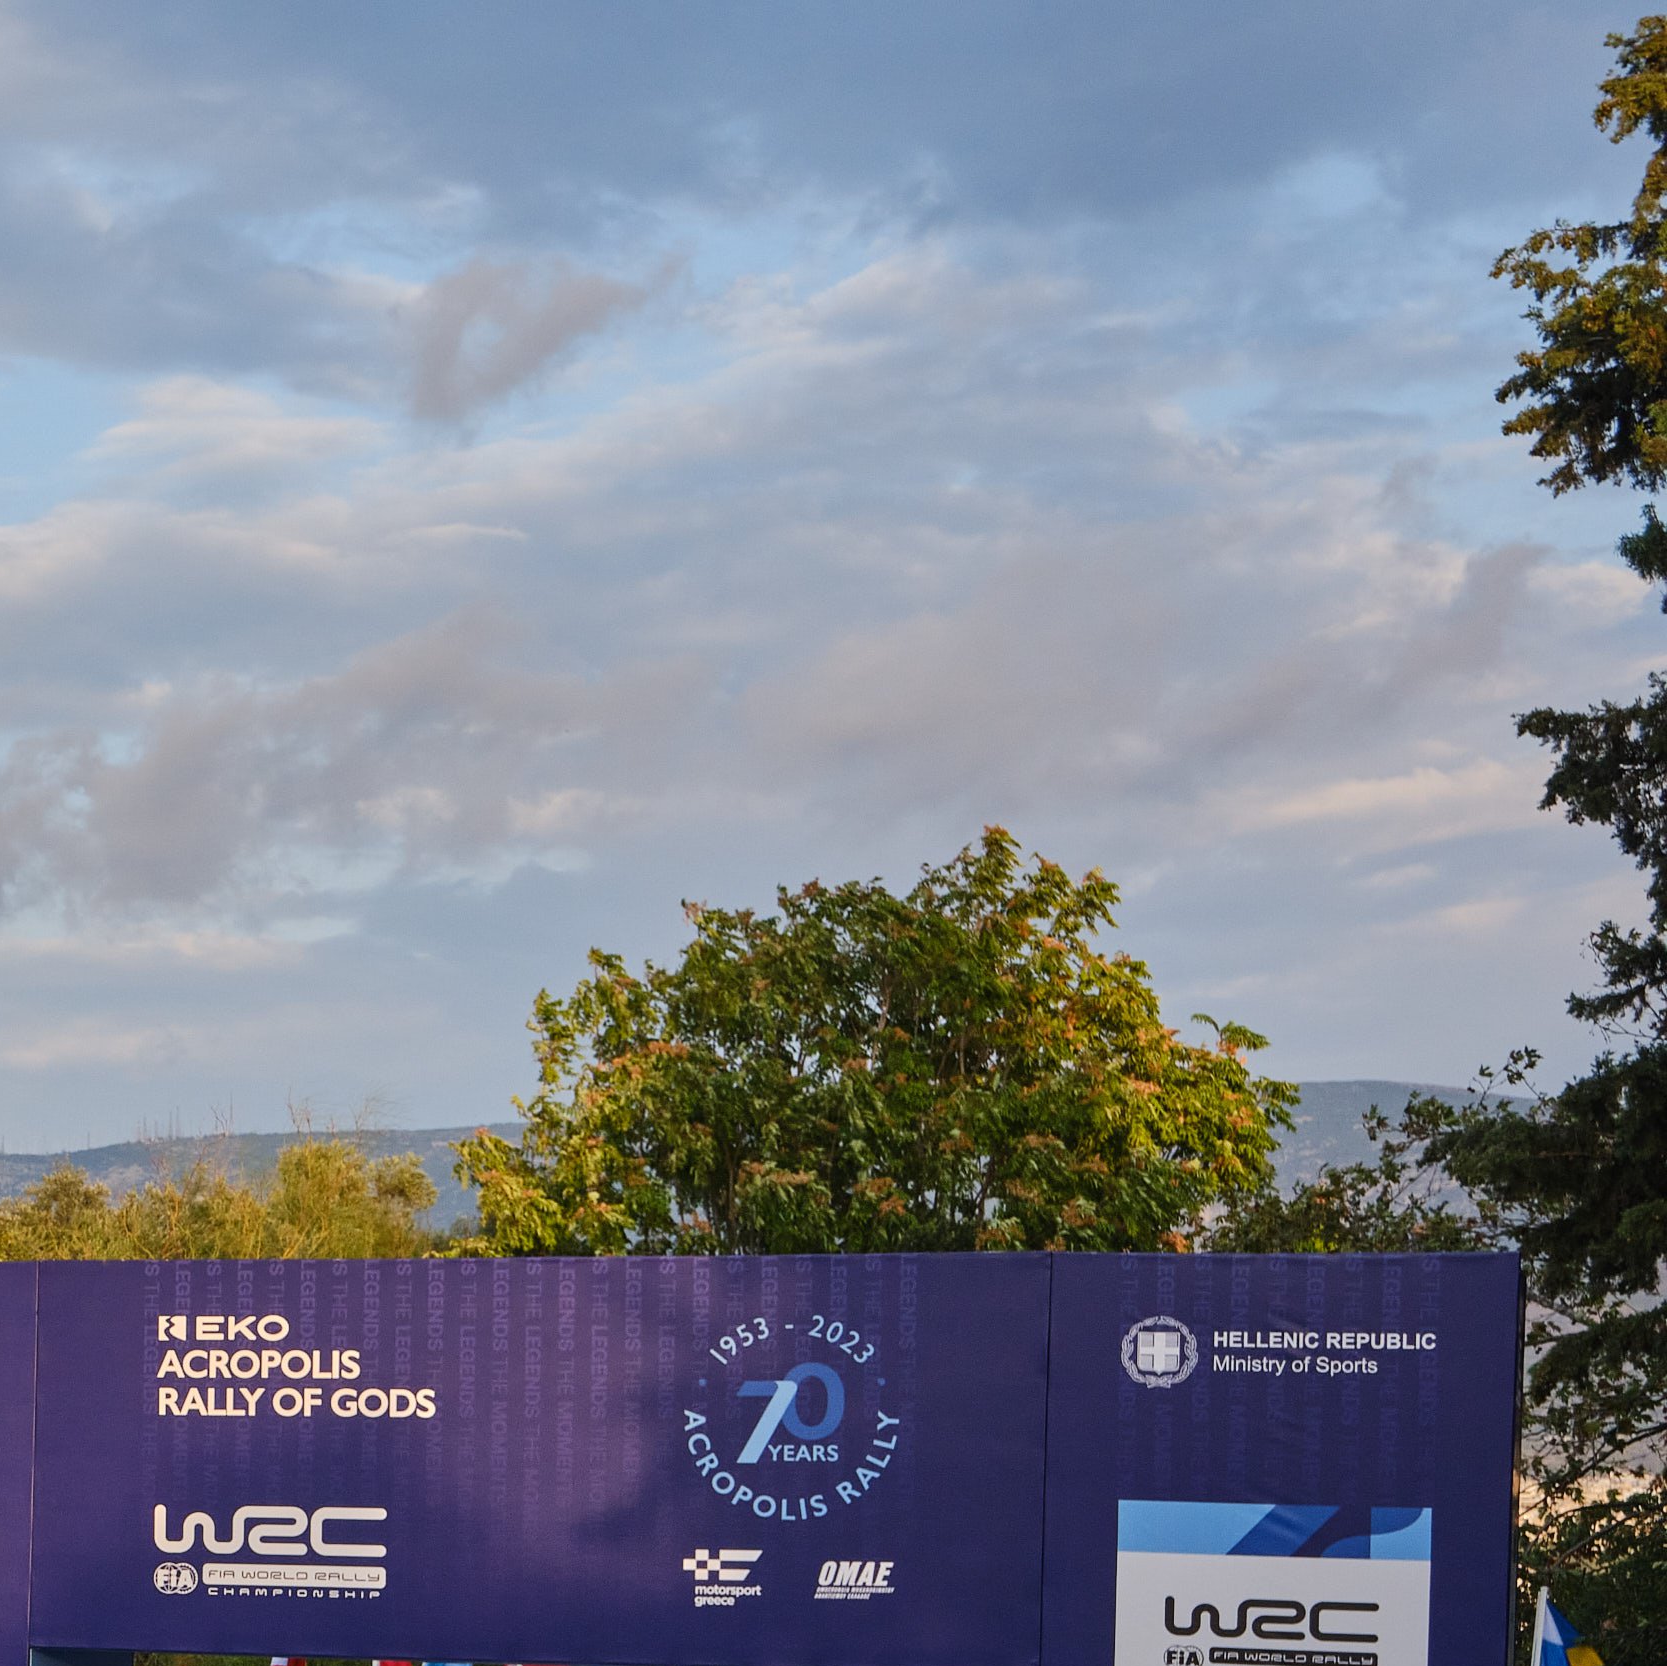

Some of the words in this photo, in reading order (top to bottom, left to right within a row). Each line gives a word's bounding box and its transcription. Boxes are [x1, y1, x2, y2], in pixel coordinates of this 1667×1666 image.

[195, 1314, 290, 1341] EKO
[710, 1317, 769, 1365] 1953
[808, 1315, 875, 1364] 2023
[1213, 1331, 1318, 1349] HELLENIC
[1326, 1332, 1436, 1350] REPUBLIC
[156, 1349, 361, 1380] ACROPOLIS
[1213, 1355, 1286, 1377] Ministry
[1291, 1355, 1311, 1373] of
[1316, 1356, 1378, 1377] Sports
[158, 1387, 265, 1417] RALLY
[272, 1387, 322, 1417] OF
[330, 1388, 436, 1419] GODS
[736, 1362, 845, 1464] 70
[684, 1409, 828, 1521] ACROPOLIS
[835, 1410, 900, 1504] RALLY
[768, 1444, 839, 1462] YEARS
[154, 1504, 387, 1558] WRC
[156, 1567, 197, 1589] FIA
[208, 1569, 235, 1579] FIA
[241, 1570, 308, 1580] WORLD
[315, 1572, 380, 1582] RALLY
[818, 1561, 894, 1587] OMAE
[208, 1587, 380, 1599] CHAMPIONSHIP
[695, 1584, 762, 1597] motorsport
[695, 1596, 735, 1607] greece
[1165, 1596, 1379, 1643] WRC
[1167, 1650, 1200, 1666] FIA
[1214, 1651, 1239, 1661] FIA
[1244, 1652, 1306, 1664] WORLD
[1312, 1654, 1373, 1666] RALLY
